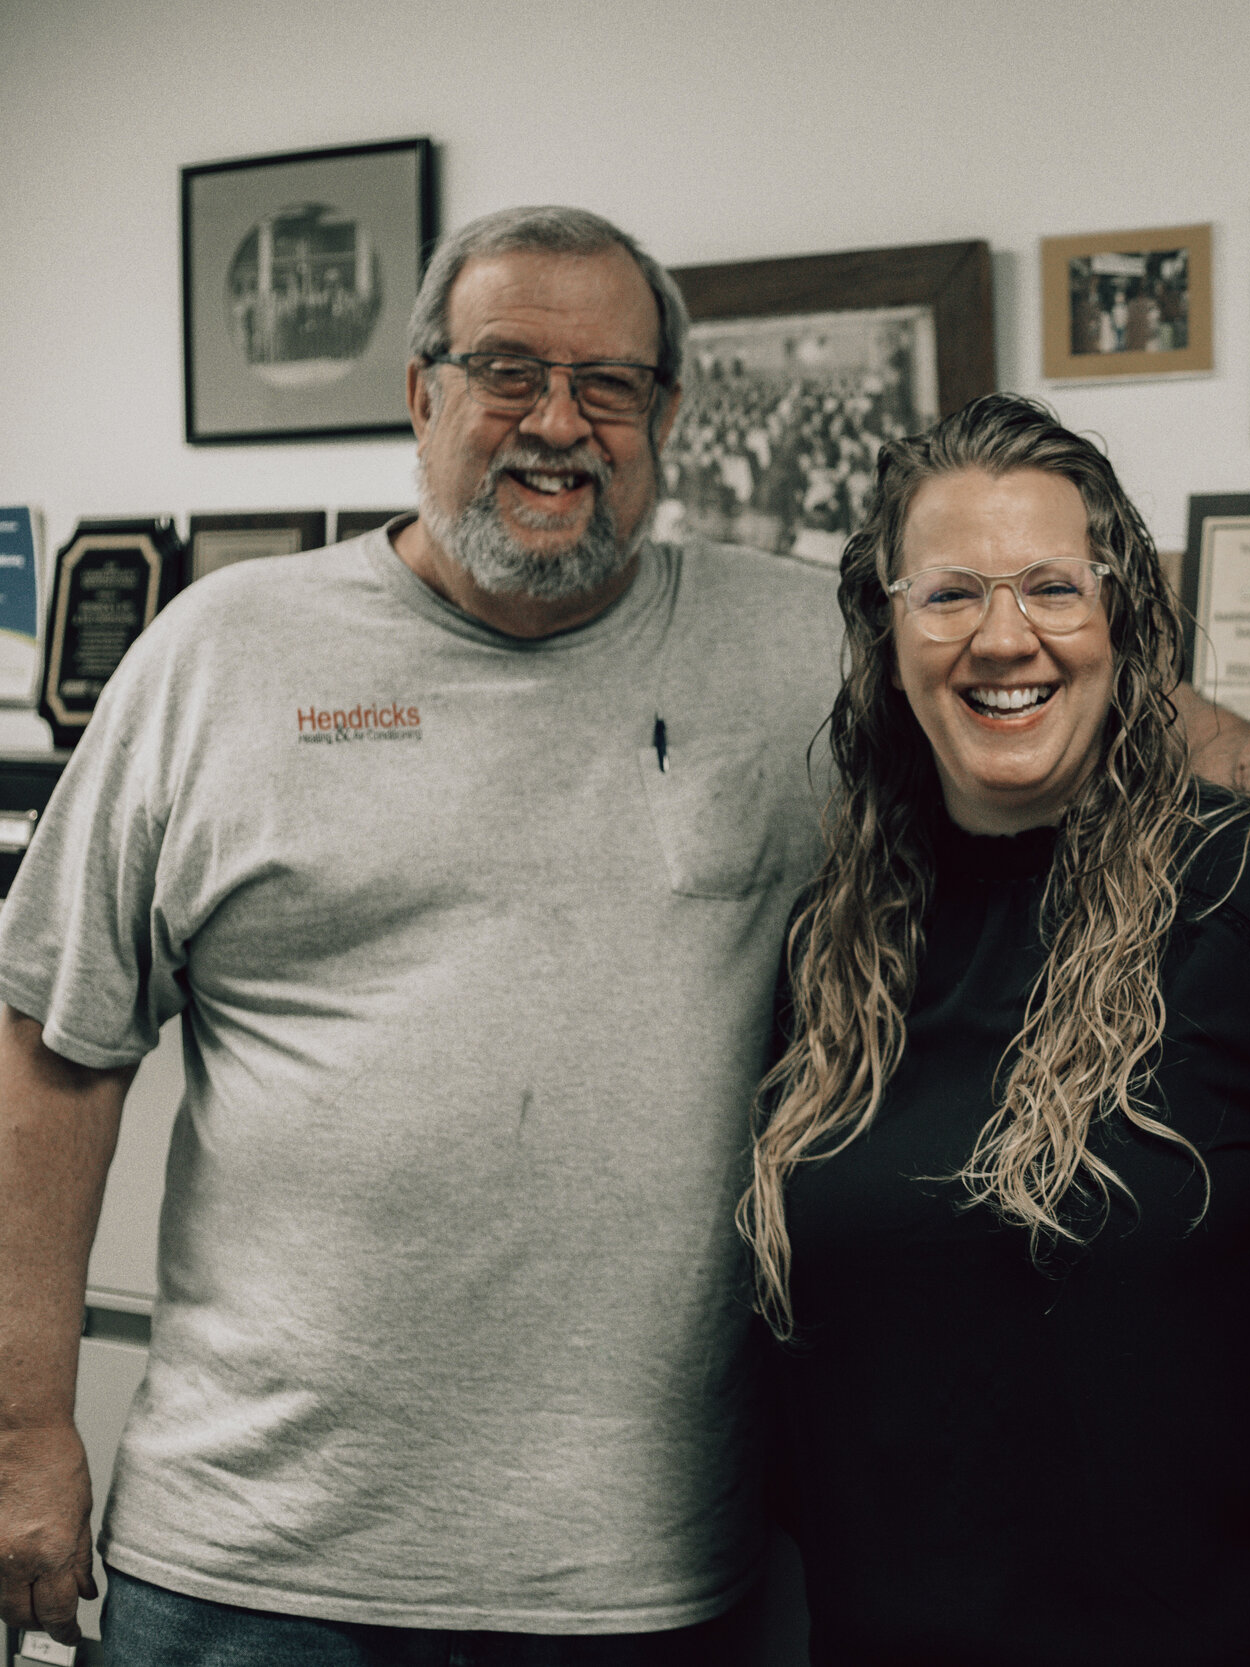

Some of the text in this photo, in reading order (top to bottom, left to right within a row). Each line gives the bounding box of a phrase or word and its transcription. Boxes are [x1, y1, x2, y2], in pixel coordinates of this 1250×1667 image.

[297, 701, 421, 732] Hendricks
[298, 733, 333, 745] Heating
[335, 724, 350, 744] &
[366, 728, 422, 742] Conditioning
